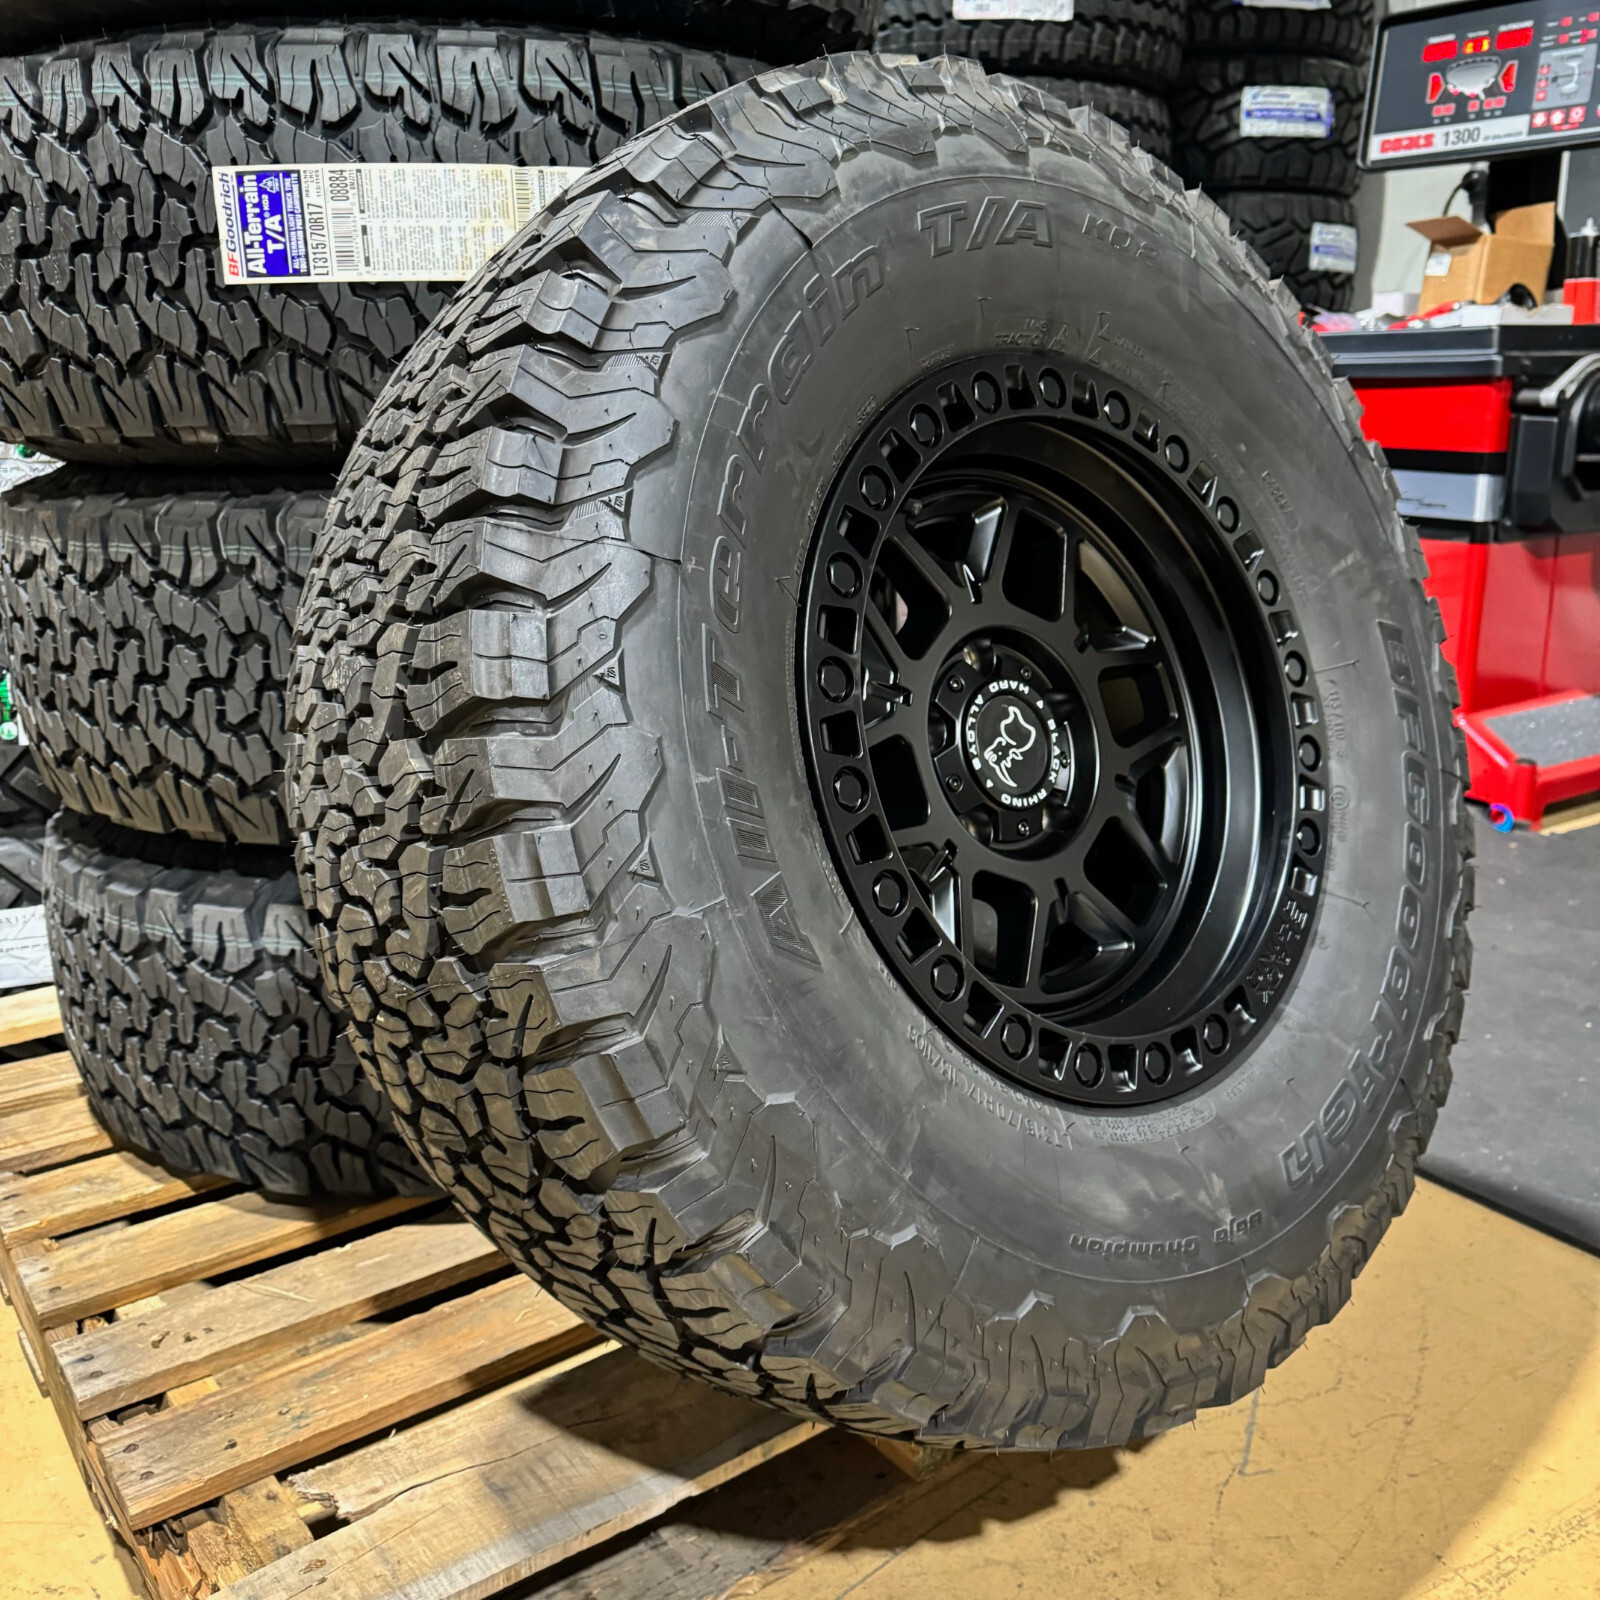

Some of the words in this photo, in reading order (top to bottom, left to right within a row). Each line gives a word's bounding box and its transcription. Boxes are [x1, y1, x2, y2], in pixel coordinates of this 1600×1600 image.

[1442, 126, 1481, 147] 1300
[284, 177, 292, 192] TIRE
[285, 192, 294, 212] TRUCK
[328, 169, 350, 202] 08884
[218, 172, 240, 277] BFGoodrich
[239, 174, 267, 274] All-Terrain
[307, 202, 330, 277] LT315/70R17
[917, 196, 1053, 258] T/A
[1081, 213, 1159, 266] KO2
[988, 679, 1030, 695] HARD
[966, 693, 985, 771] ALLOYS
[1047, 718, 1061, 784] BLACK
[1000, 788, 1048, 808] RHINO
[1278, 619, 1435, 1192] BFGoodrich
